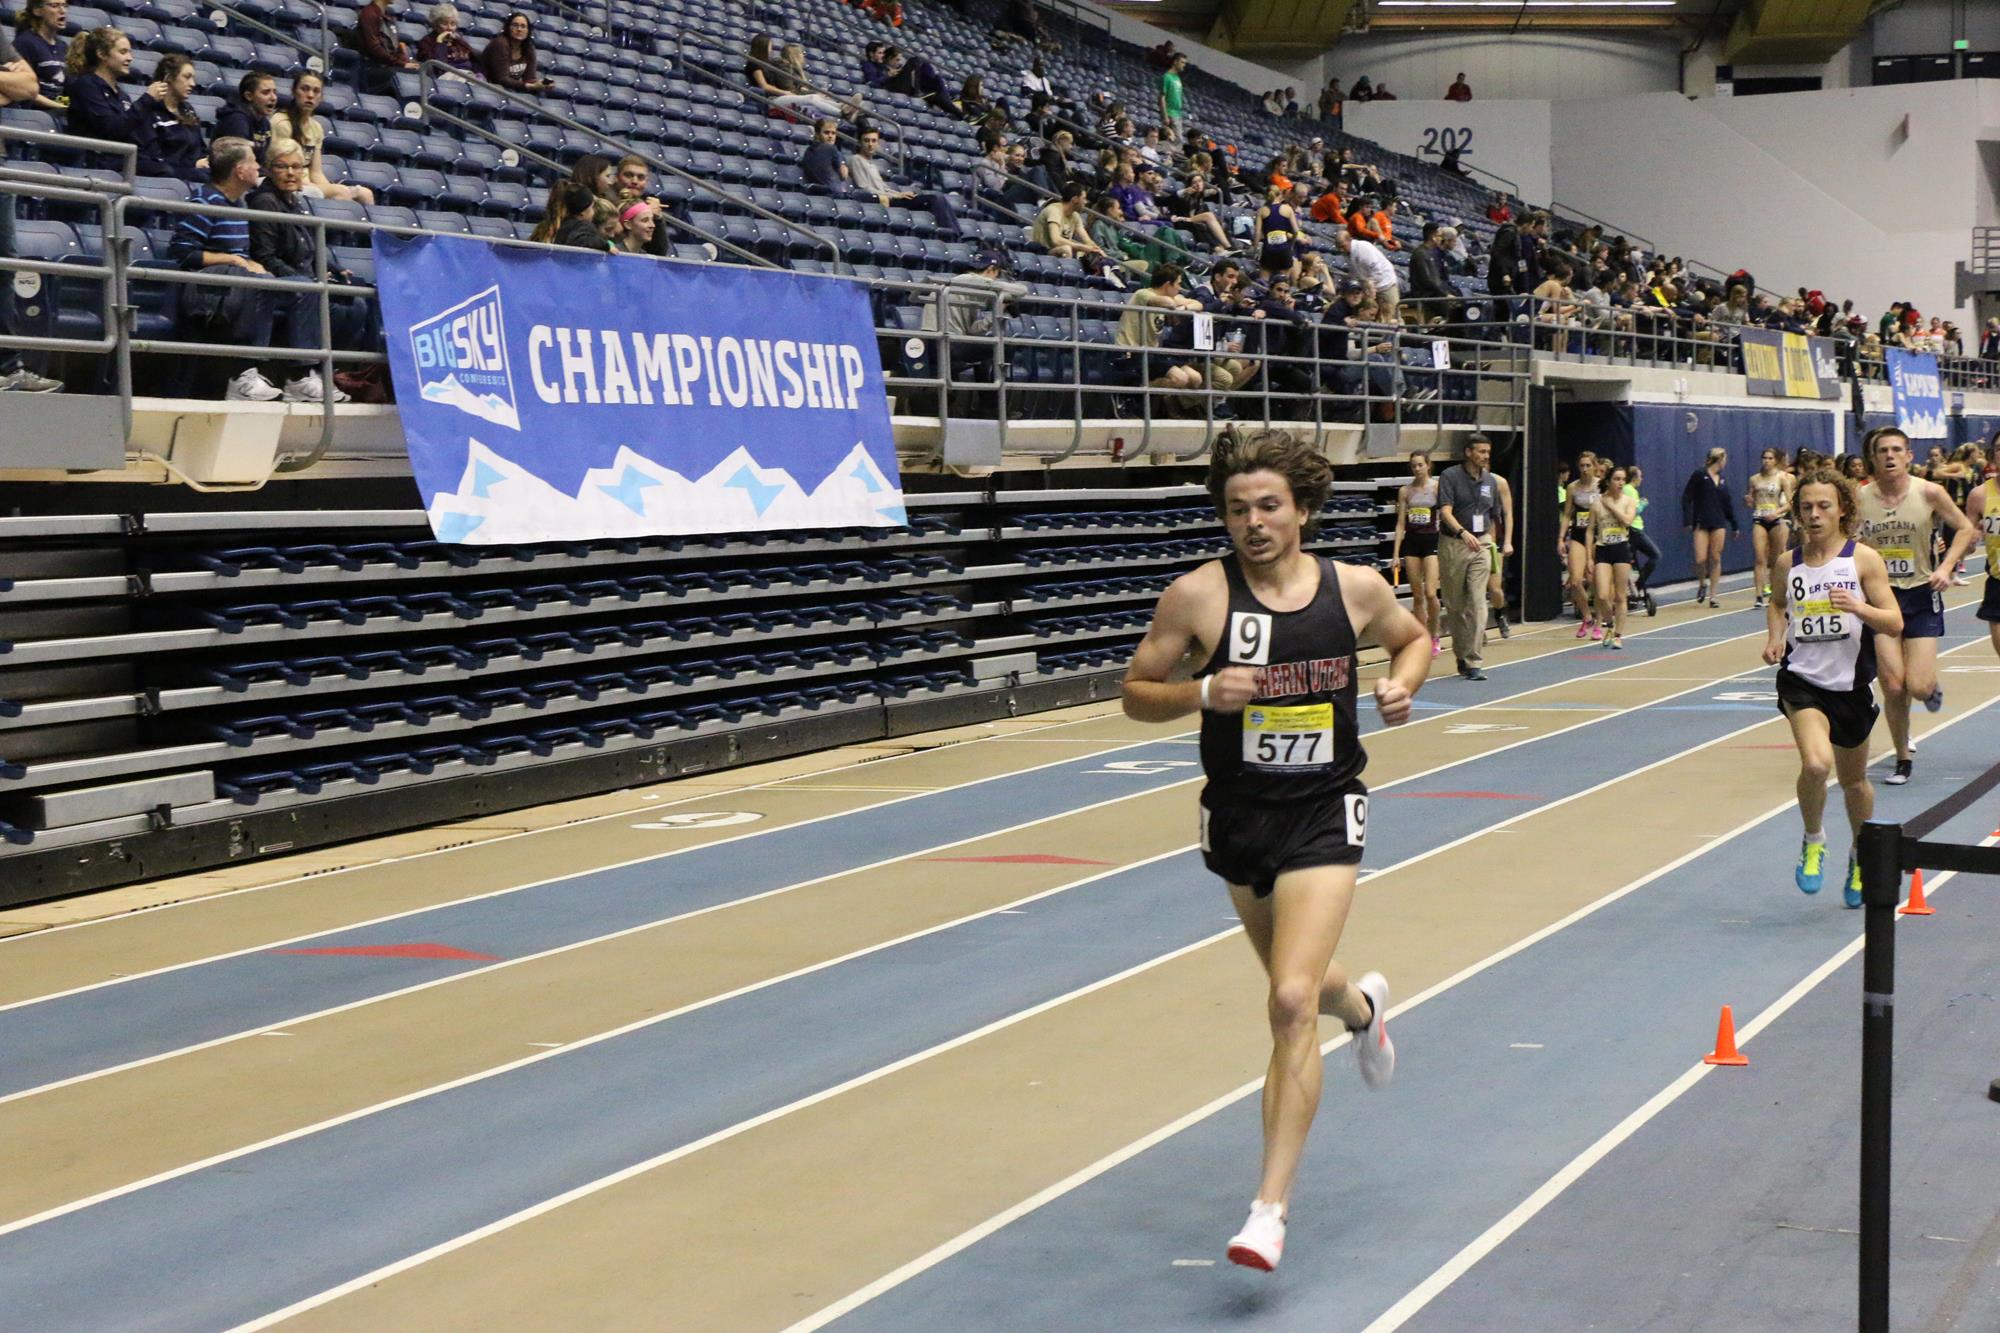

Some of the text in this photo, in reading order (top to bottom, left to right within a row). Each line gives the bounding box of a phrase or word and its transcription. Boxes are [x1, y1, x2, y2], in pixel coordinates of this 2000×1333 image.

[1424, 127, 1473, 154] 202
[528, 324, 865, 410] CHAMPIONSHIP
[1876, 534, 1911, 544] STATE
[1883, 559, 1909, 572] 10
[1792, 576, 1806, 602] 8
[1239, 615, 1261, 660] 9
[1801, 615, 1842, 635] 615
[1254, 661, 1308, 699] HERN
[1256, 732, 1322, 763] 577
[1354, 798, 1365, 842] 9
